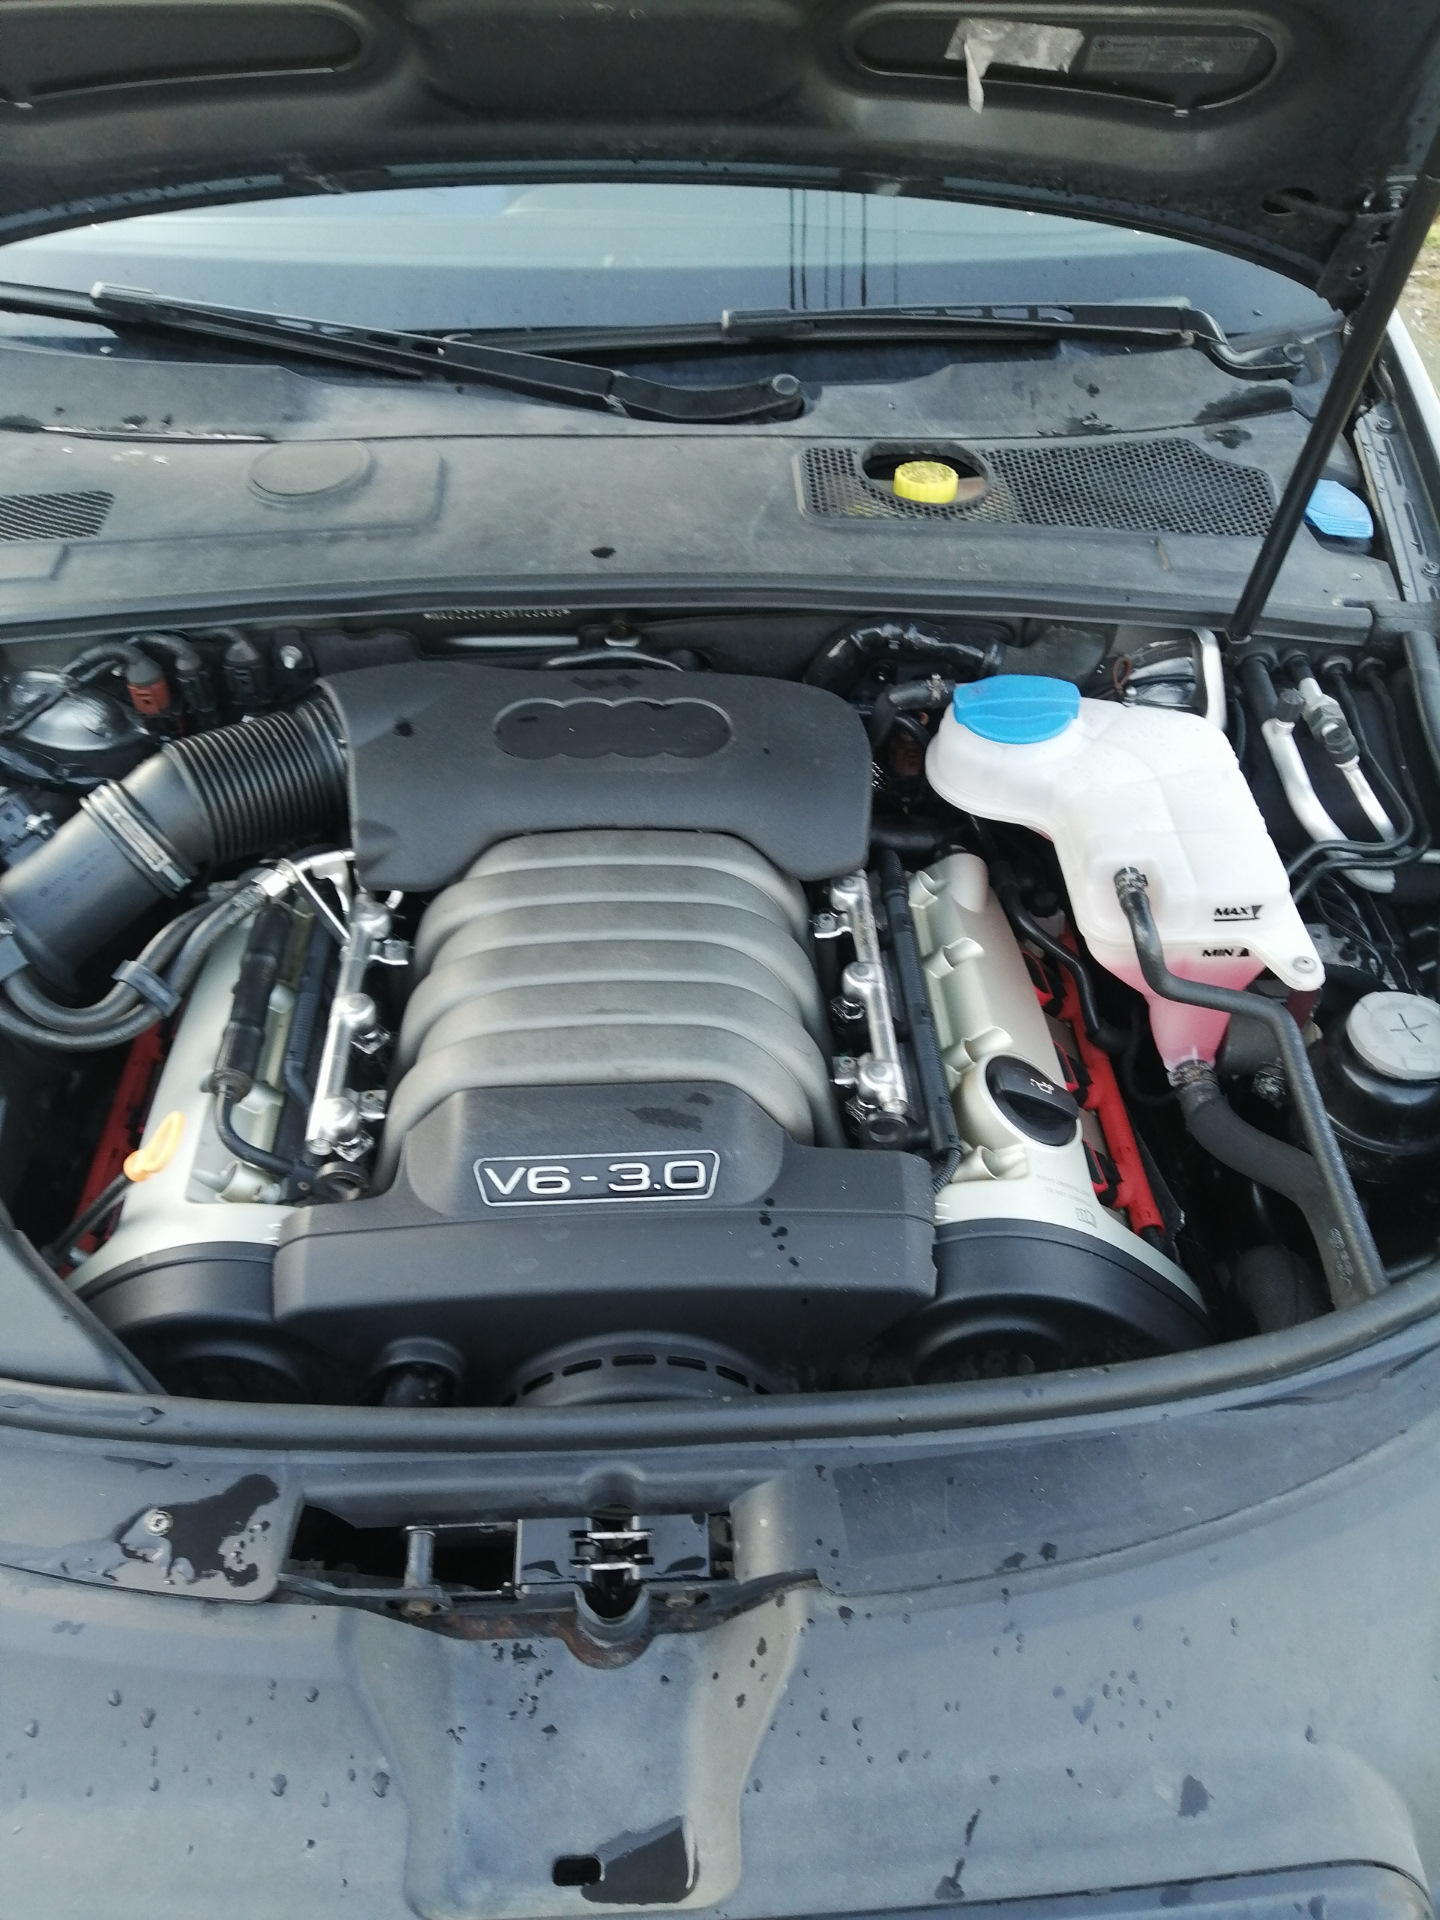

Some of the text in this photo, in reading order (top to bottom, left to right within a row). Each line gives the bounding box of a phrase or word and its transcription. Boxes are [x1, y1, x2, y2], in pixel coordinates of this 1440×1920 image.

[1214, 906, 1250, 916] MAX
[1202, 948, 1234, 957] MIN
[484, 1166, 571, 1195] V6
[608, 1160, 706, 1192] 3.0
